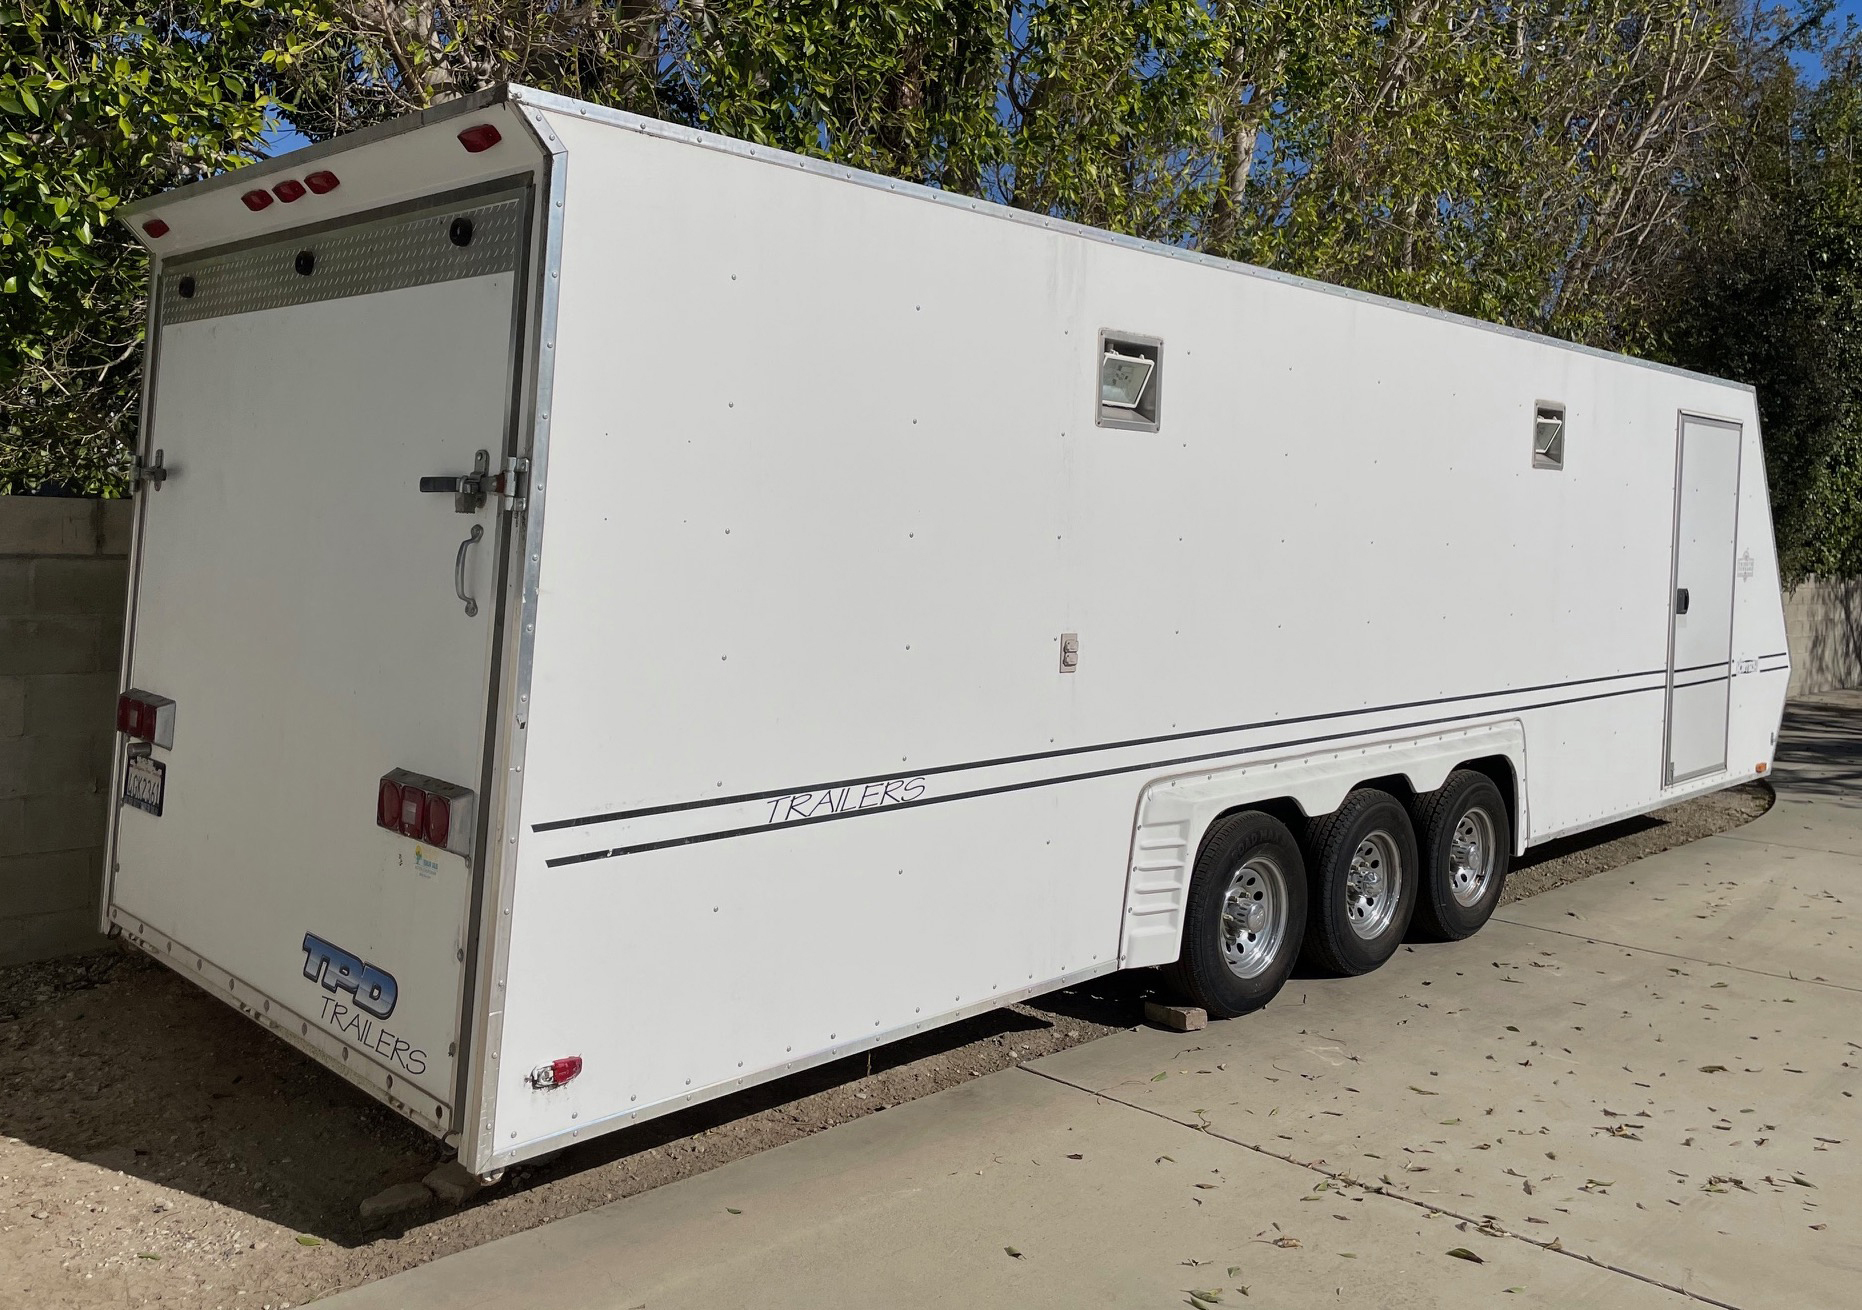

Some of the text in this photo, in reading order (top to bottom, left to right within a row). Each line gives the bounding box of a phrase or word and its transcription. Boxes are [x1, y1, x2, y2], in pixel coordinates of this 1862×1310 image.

[766, 776, 926, 824] TRAILERS
[302, 931, 398, 1021] TPD
[321, 995, 428, 1075] TRAILERS
